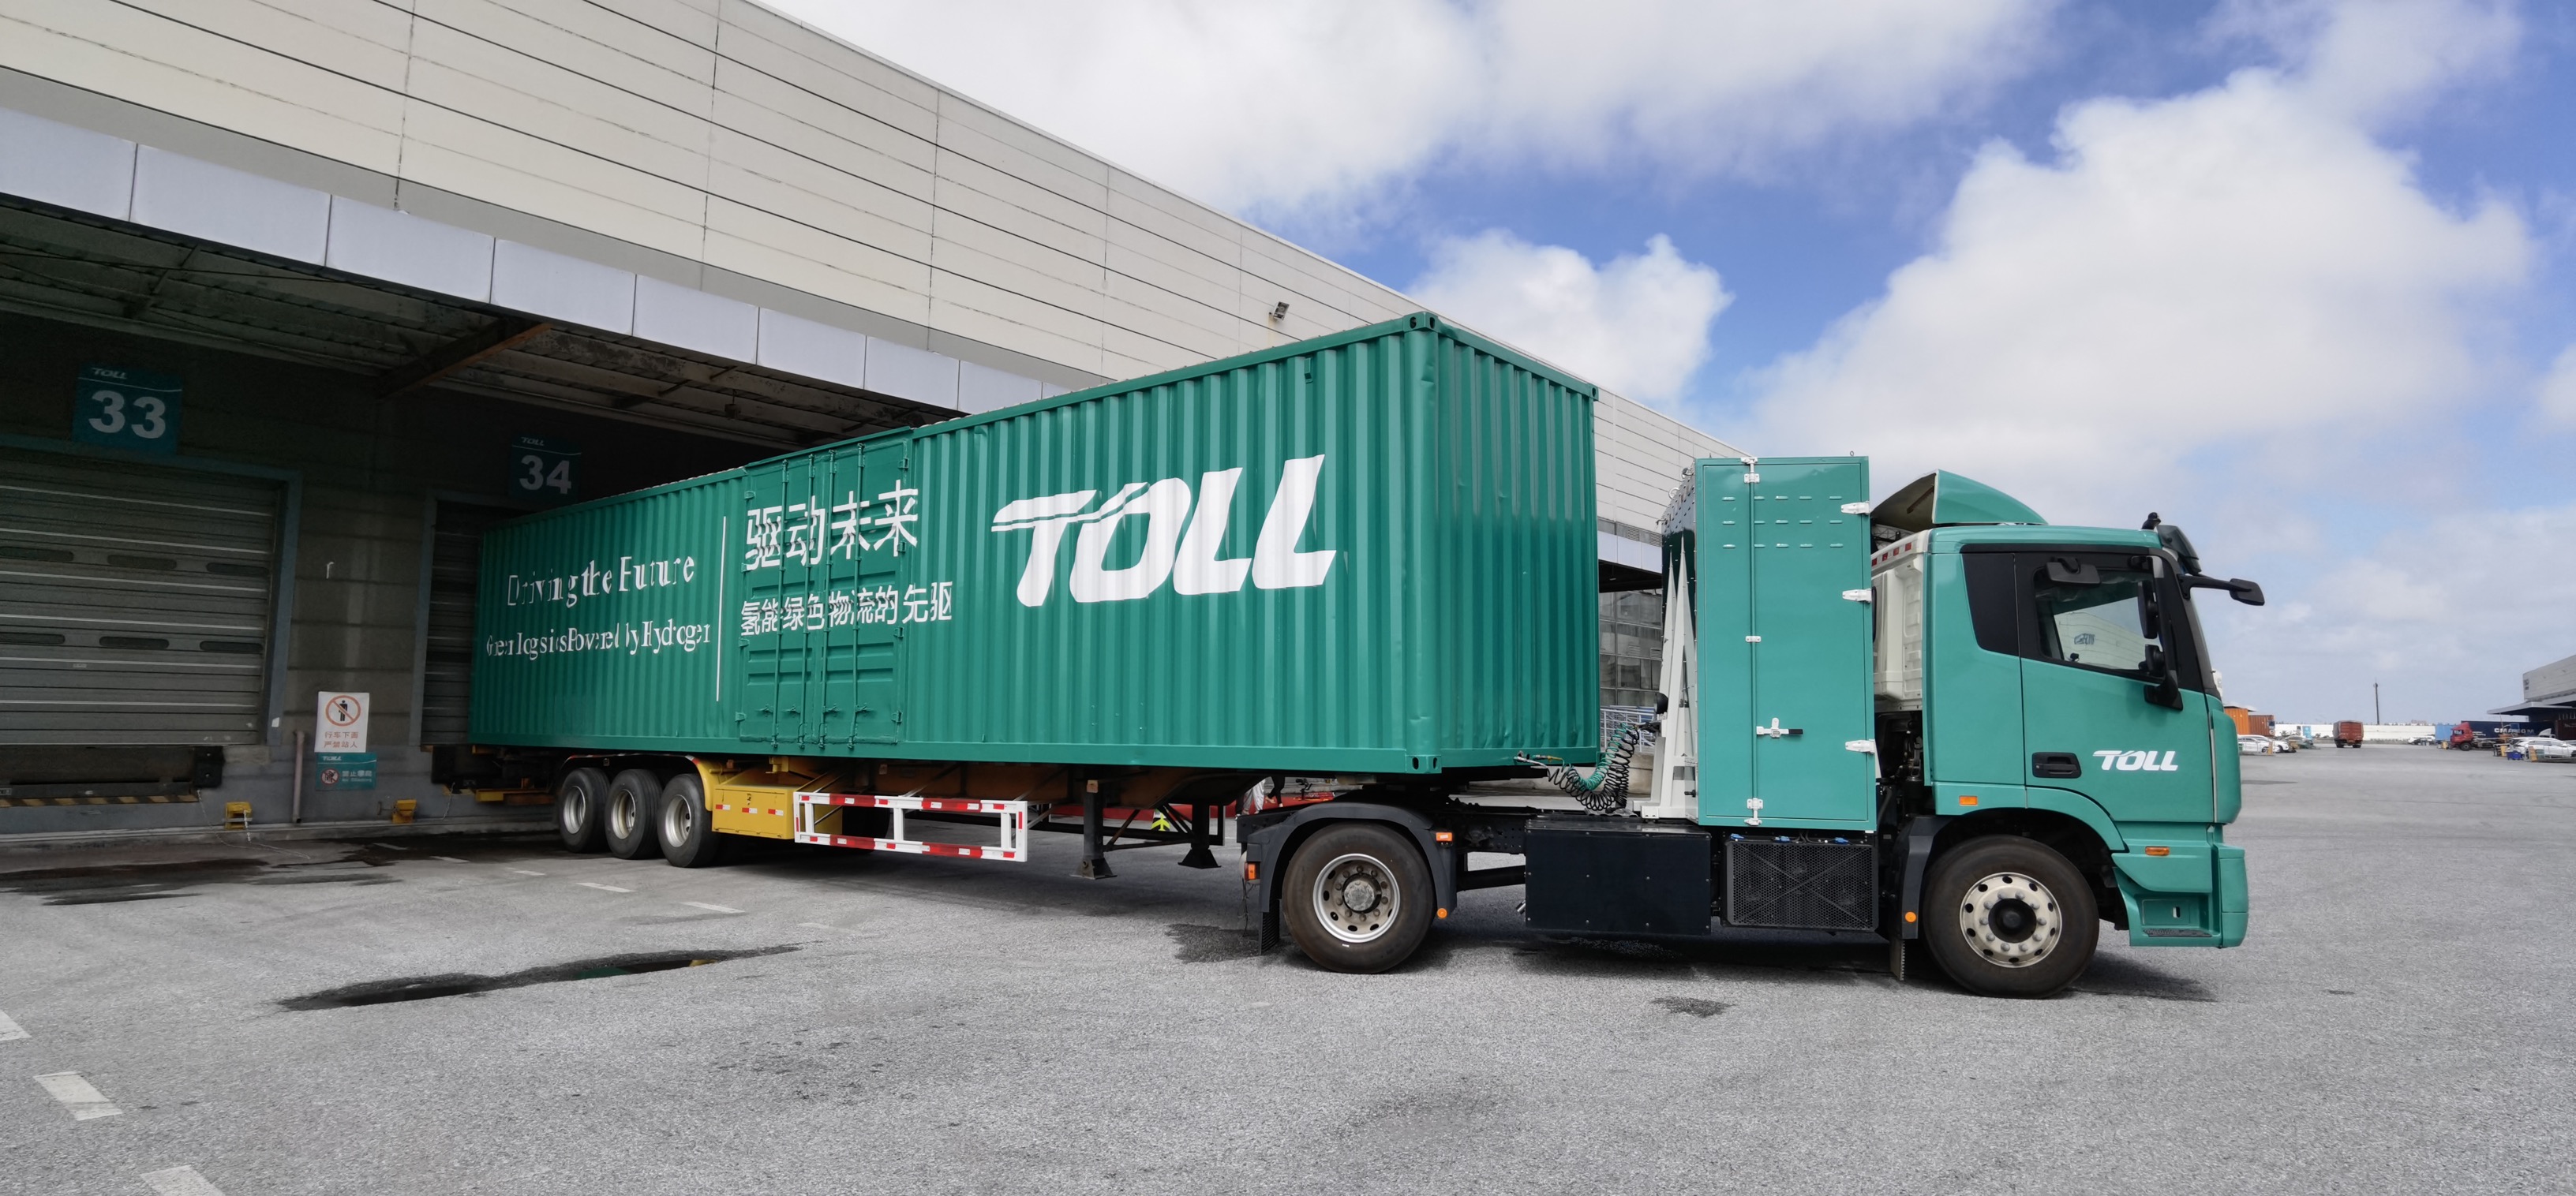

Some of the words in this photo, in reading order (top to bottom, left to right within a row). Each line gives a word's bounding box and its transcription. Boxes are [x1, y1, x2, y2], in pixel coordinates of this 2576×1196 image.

[92, 368, 127, 379] TOLL
[88, 390, 166, 439] 33
[521, 436, 545, 447] TOLL
[519, 454, 572, 495] 34
[745, 479, 918, 570] 驱动未来
[991, 454, 1336, 607] TOLL
[507, 568, 578, 608] Driving
[618, 555, 695, 592] Future
[741, 581, 953, 636] 氢能绿色物流的先驱
[642, 618, 710, 655] Hydogn
[2092, 749, 2178, 771] TOLL
